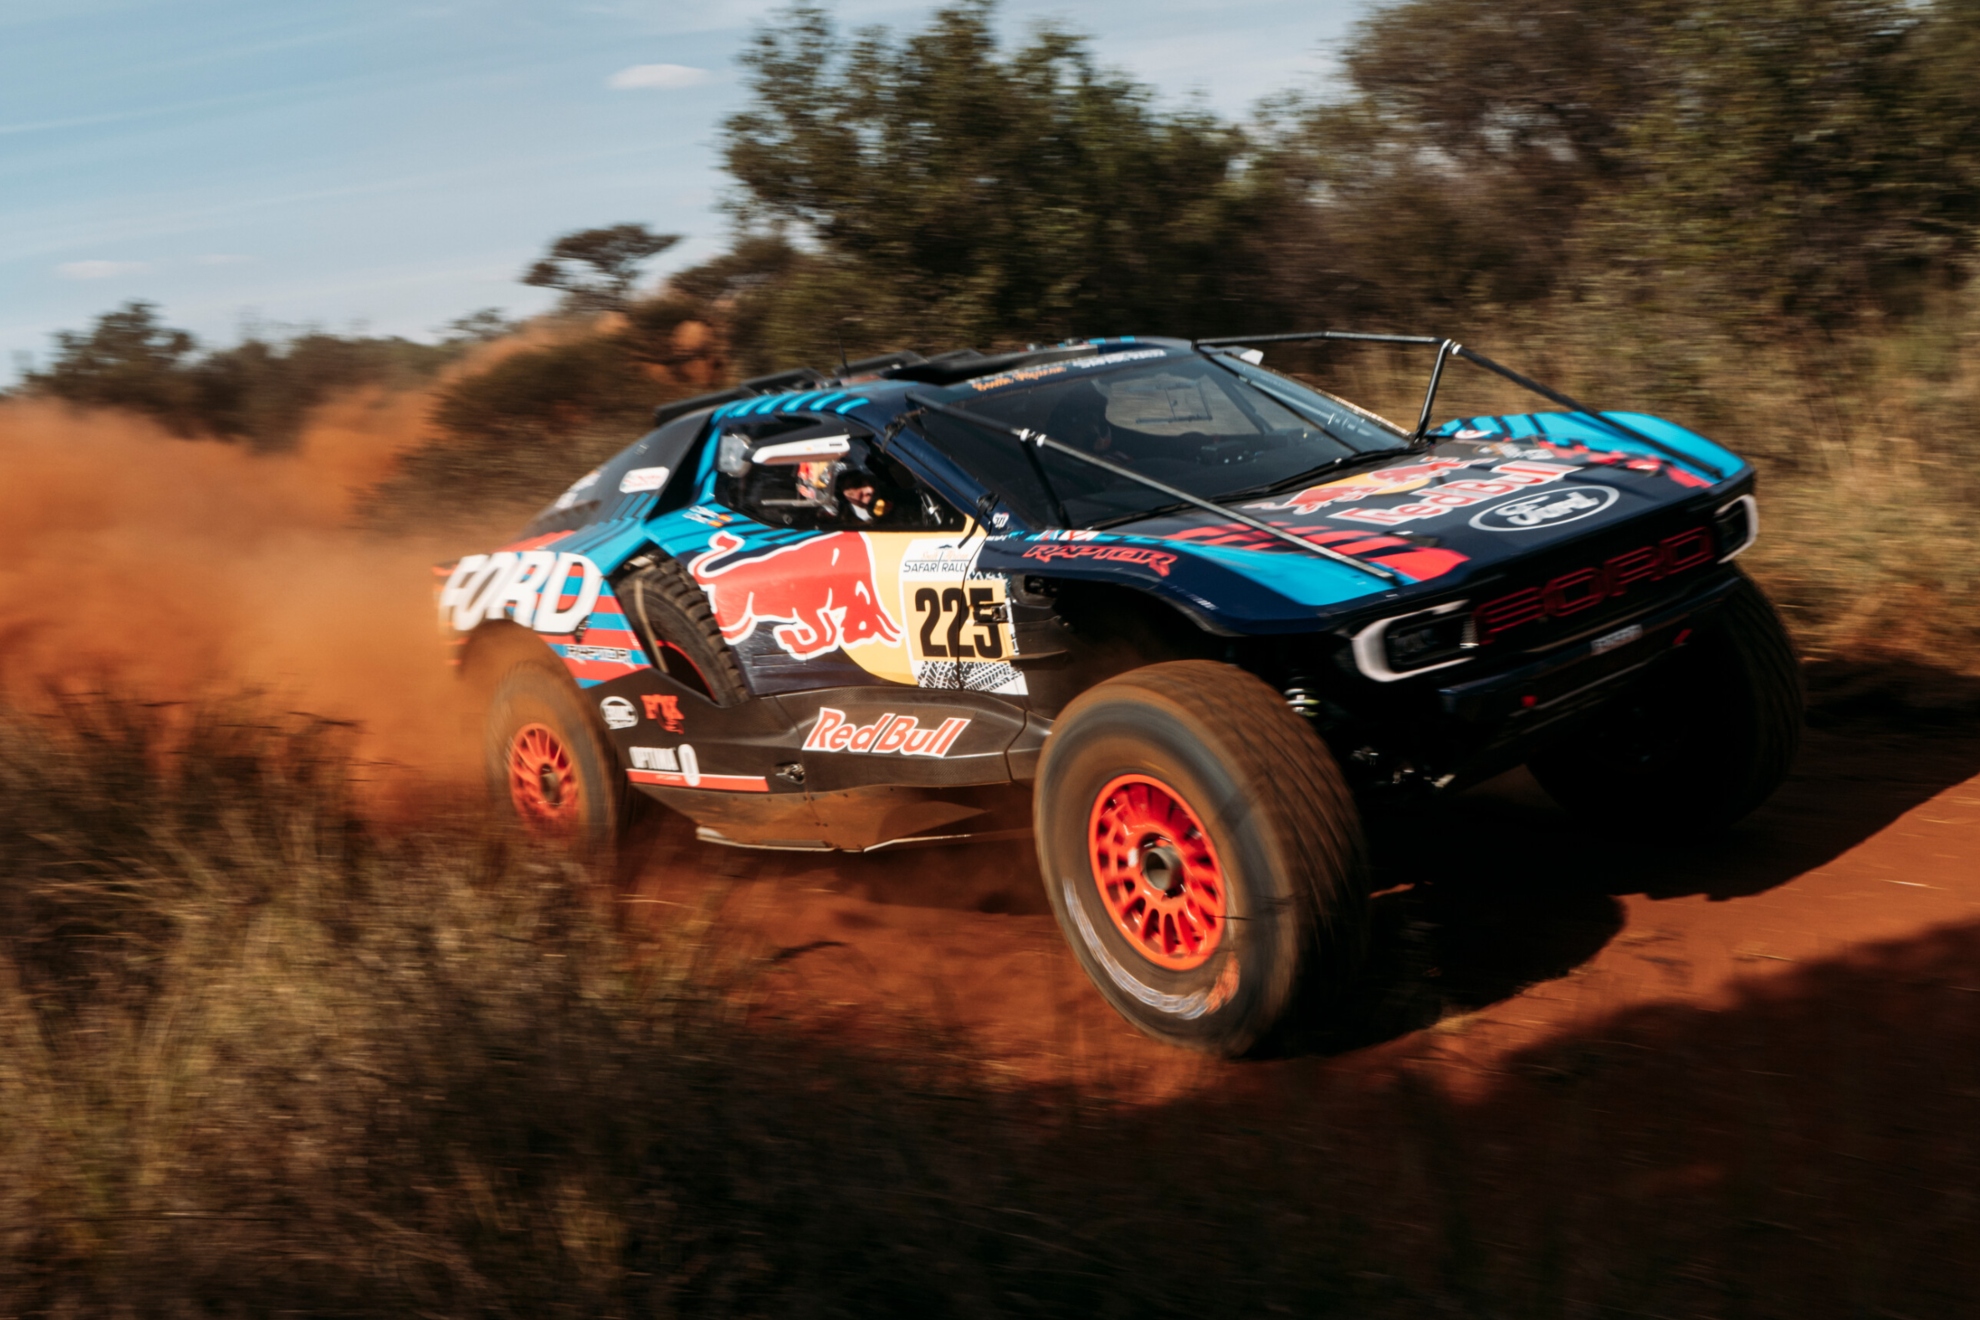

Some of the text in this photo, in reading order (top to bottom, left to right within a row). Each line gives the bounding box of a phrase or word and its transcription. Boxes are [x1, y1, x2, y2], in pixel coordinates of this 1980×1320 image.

[1494, 490, 1600, 526] Ford
[1022, 544, 1179, 578] RAPTOR
[442, 551, 603, 633] FORD
[915, 587, 1003, 659] 225
